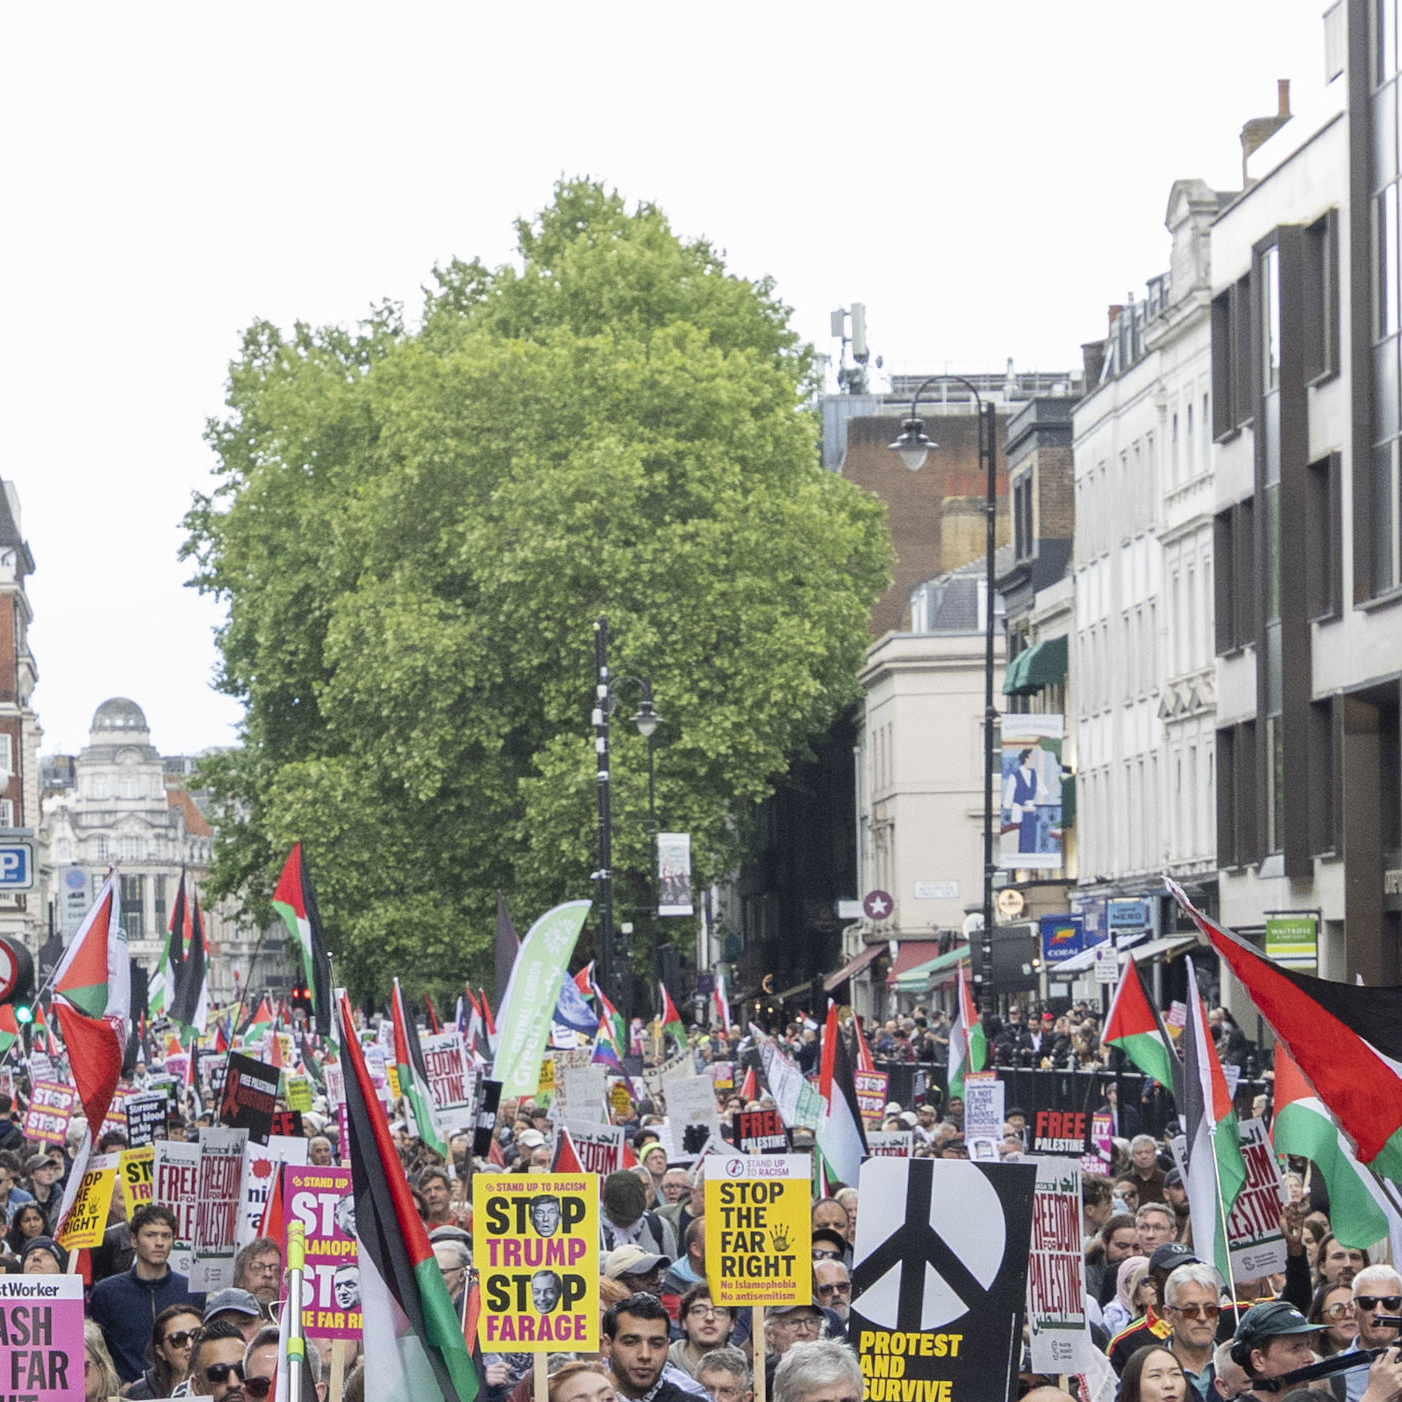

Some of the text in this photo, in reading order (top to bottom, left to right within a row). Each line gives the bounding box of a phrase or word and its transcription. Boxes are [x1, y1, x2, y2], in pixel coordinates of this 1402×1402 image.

[1113, 911, 1142, 921] NERO
[1035, 1111, 1086, 1138] FREE
[741, 1135, 786, 1150] PALESTINE
[1034, 1137, 1085, 1152] PALESTINE
[746, 1160, 785, 1168] STAND UP
[758, 1168, 789, 1176] RACISM
[201, 1155, 243, 1200] FREEDOM
[304, 1177, 348, 1188] STAND UP
[496, 1182, 586, 1192] STAND UP TO RACISM
[209, 1190, 223, 1200] FOR
[720, 1182, 784, 1204] STOP
[486, 1196, 586, 1234] STP
[720, 1207, 767, 1229] THE
[486, 1238, 587, 1267] TRUMP
[721, 1231, 766, 1253] FAR
[1043, 1239, 1056, 1249] FOR
[721, 1255, 796, 1278] RIGHT
[486, 1274, 587, 1312] STP
[721, 1280, 796, 1291] No Islamophobia
[1029, 1253, 1084, 1313] PALESTINE
[721, 1292, 796, 1301] No antisemitism
[318, 1313, 345, 1328] FAR
[486, 1314, 587, 1341] FARAGE
[860, 1331, 963, 1357] PROTEST
[11, 1351, 69, 1390] FAR
[860, 1354, 905, 1379] AND
